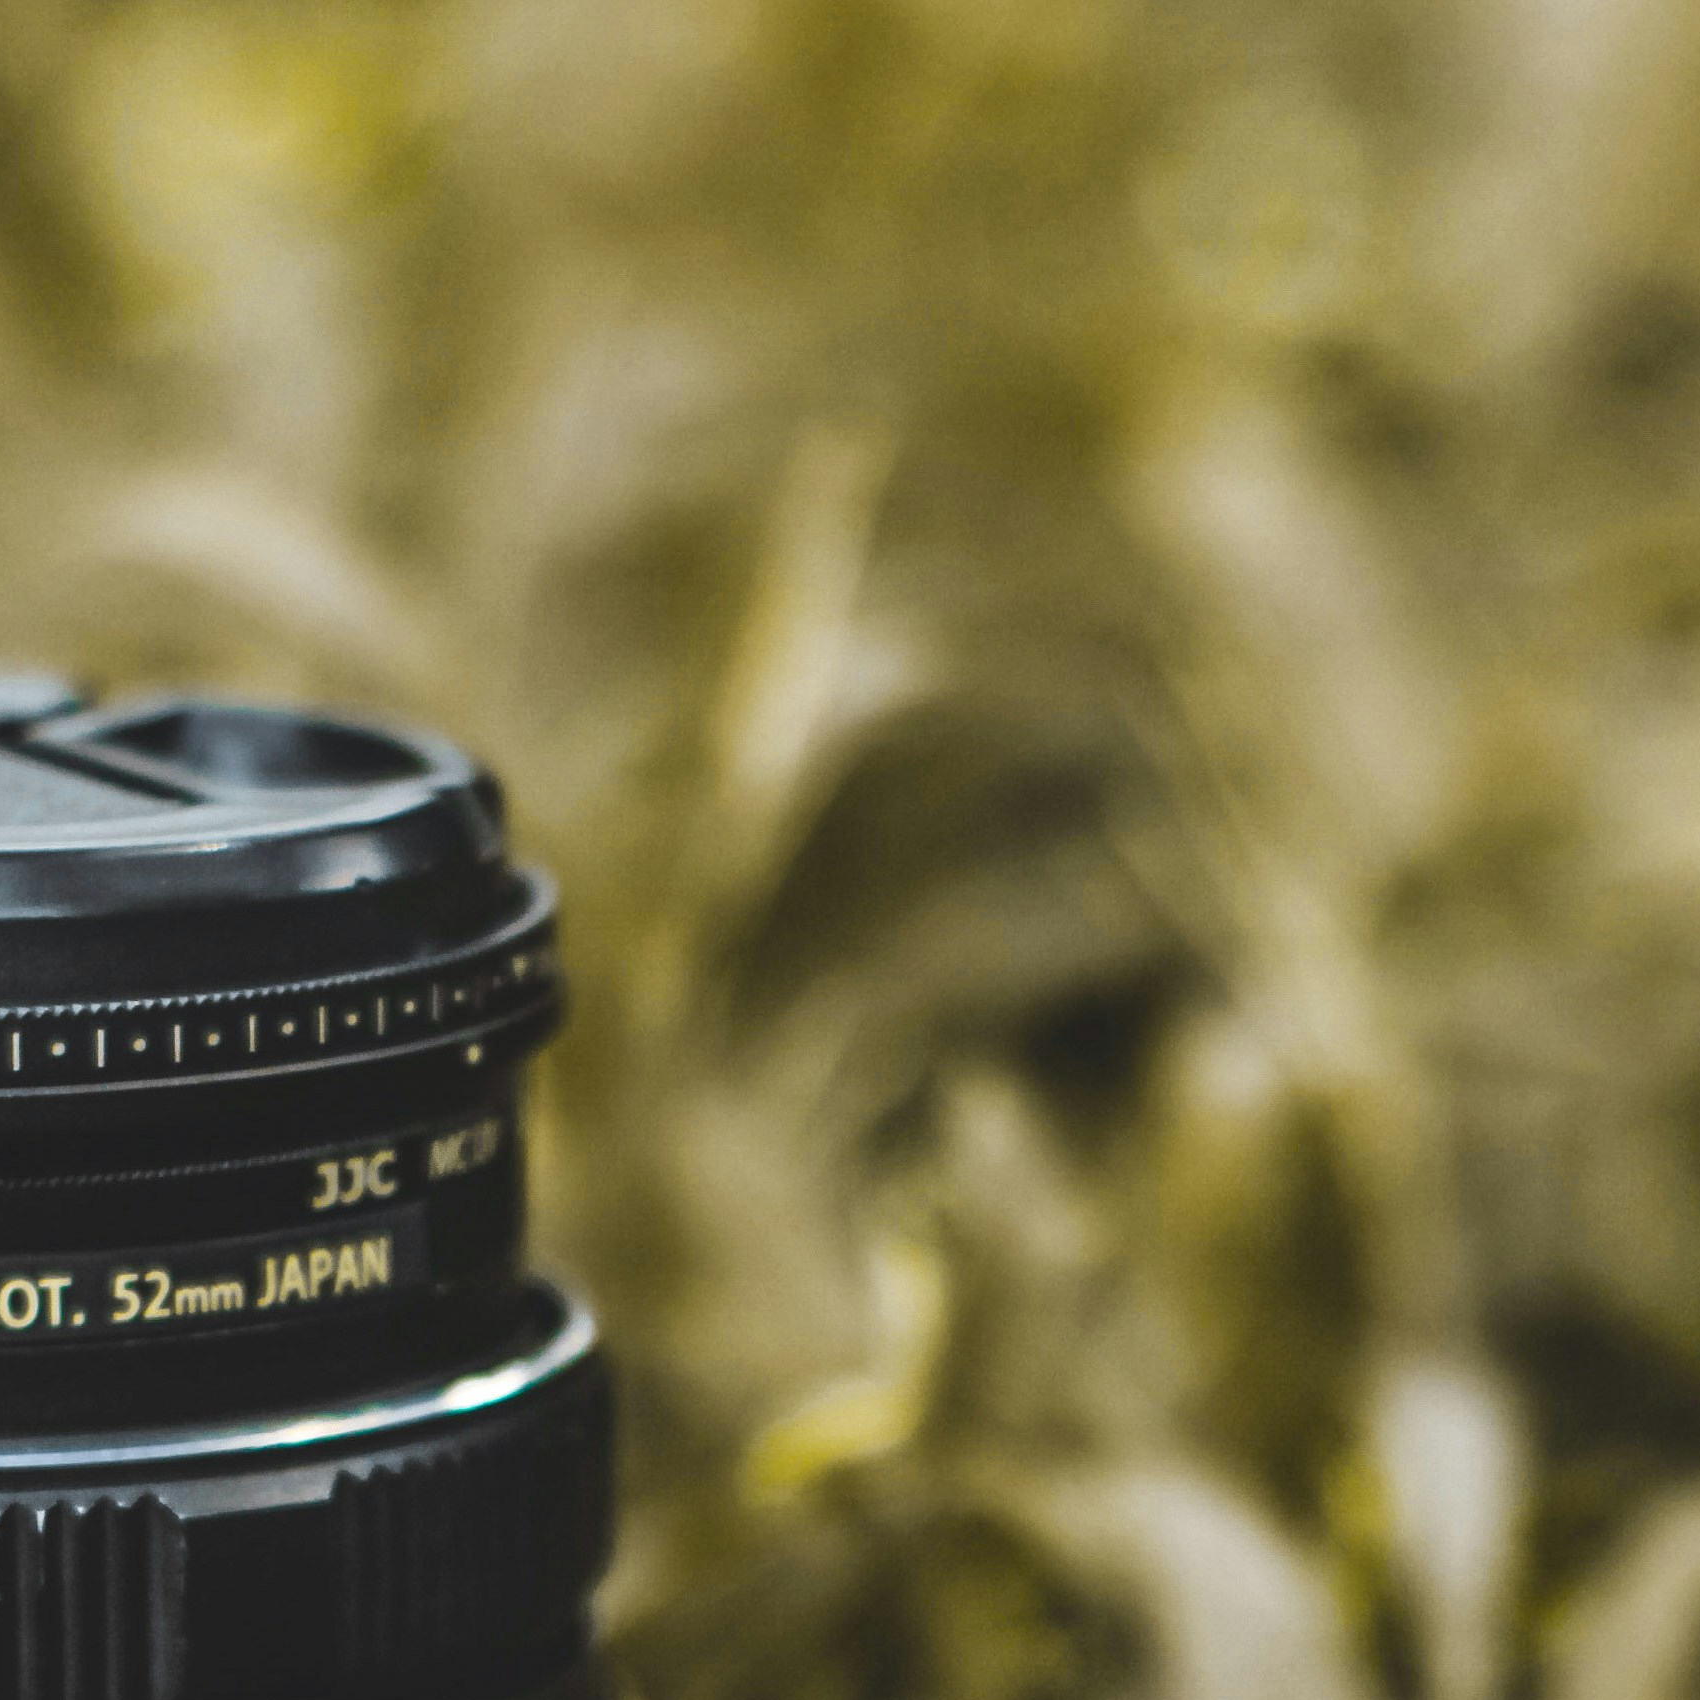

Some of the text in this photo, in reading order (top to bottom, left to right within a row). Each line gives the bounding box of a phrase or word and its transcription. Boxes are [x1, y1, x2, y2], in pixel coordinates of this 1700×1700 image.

[311, 1149, 396, 1210] JJC
[111, 1268, 245, 1324] 52mm
[256, 1236, 391, 1308] JAPAN
